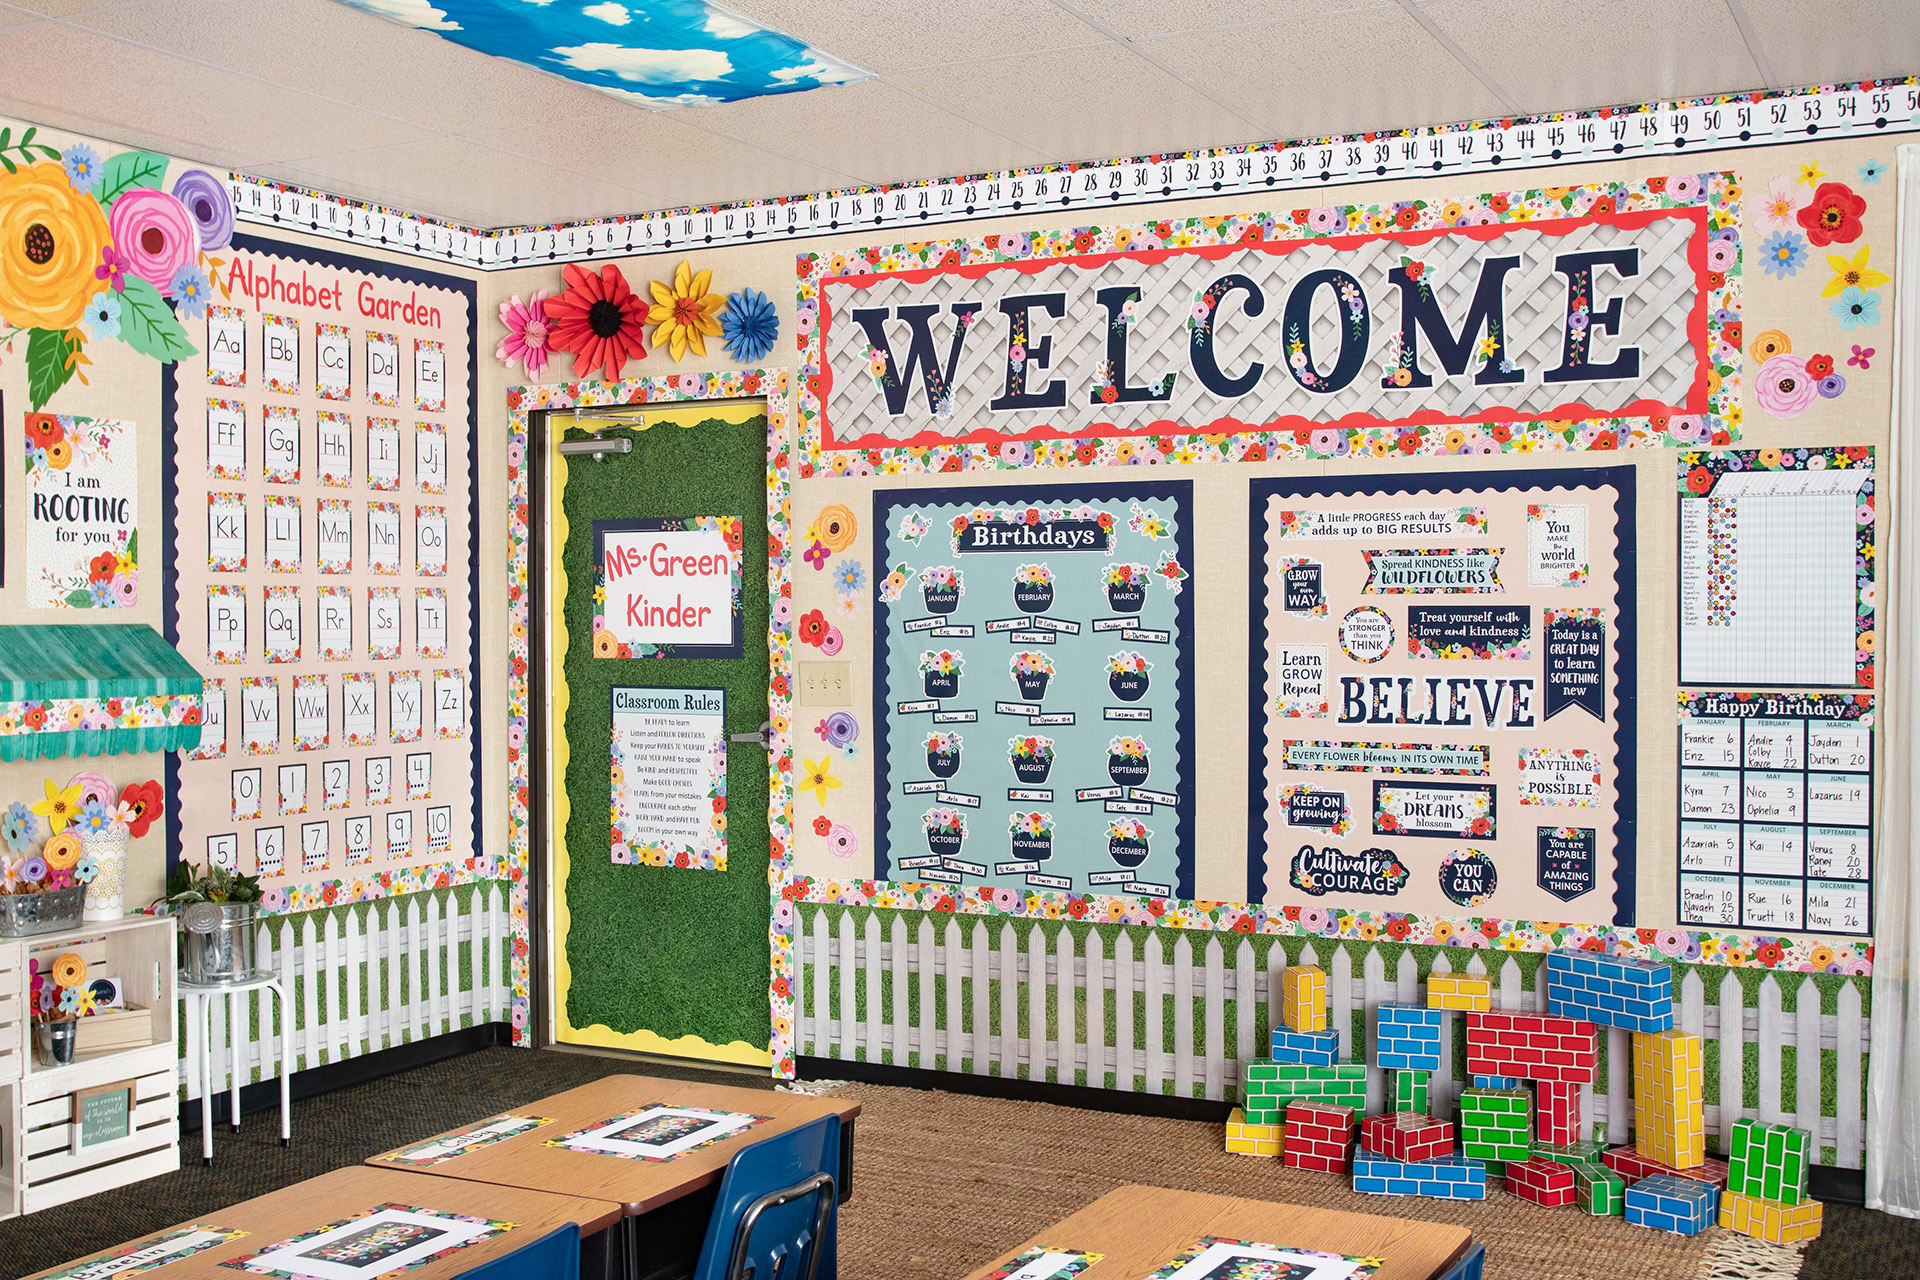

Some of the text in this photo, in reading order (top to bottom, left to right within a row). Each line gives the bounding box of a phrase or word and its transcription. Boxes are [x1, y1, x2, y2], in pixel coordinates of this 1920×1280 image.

[1737, 94, 1890, 127] 51 52 53 54 55
[227, 257, 441, 329] Alphabet Garden
[851, 247, 1639, 416] WELCOME
[213, 330, 438, 383] Aa Bb Cc Dd Ee
[65, 472, 101, 488] I am
[34, 493, 129, 524] ROOTING
[1317, 511, 1446, 522] A little PROGRESS each day
[1312, 523, 1452, 537] adds up to BIG RESULTS
[1546, 521, 1570, 533] You
[56, 527, 110, 545] for you
[971, 524, 1095, 548] Birthdays
[650, 543, 728, 577] Green
[1541, 548, 1575, 561] world
[1382, 558, 1485, 571] Spread KINDNESS like
[1287, 569, 1318, 582] GROW
[1381, 568, 1486, 584] WILDFLOWERS
[1292, 581, 1308, 590] your
[927, 594, 956, 602] JANUARY
[1017, 593, 1050, 601] FEBRUARY
[1113, 592, 1139, 600] MARCH
[1288, 594, 1318, 607] WAY
[627, 594, 711, 627] Kinder
[1419, 611, 1521, 625] Treat yourself with
[1348, 624, 1386, 632] STRONGER
[1419, 625, 1519, 636] love and kindness
[1369, 633, 1381, 641] you
[1552, 629, 1577, 642] Today
[1580, 631, 1588, 640] is
[1351, 639, 1383, 650] THINK
[1550, 643, 1599, 655] GREAT DAY
[1282, 651, 1322, 666] Learn
[1554, 658, 1595, 670] to learn
[1282, 668, 1322, 680] GROW
[1550, 672, 1599, 684] SOMETHING
[1025, 680, 1040, 688] MAY
[1121, 681, 1138, 689] JUNE
[1283, 681, 1322, 697] Repeat
[1563, 686, 1587, 695] new
[616, 692, 720, 711] Classroom Rules
[1338, 677, 1534, 727] BELIEVE
[1705, 699, 1845, 719] Happy Birthday
[1684, 733, 1734, 744] Frankie 6
[1749, 734, 1773, 745] Andie
[1292, 751, 1479, 764] EVERY FLOWER blooms IN ITS OWN TIME
[1748, 747, 1771, 758] Colby
[937, 759, 951, 767] JULY
[1809, 754, 1865, 765] Dutton 20
[1019, 763, 1045, 772] AUGUST
[1111, 766, 1147, 774] SEPTEMBER
[1529, 760, 1593, 772] ANYTHING
[1556, 772, 1565, 781] is
[1528, 783, 1592, 796] POSSIBLE
[1747, 786, 1766, 798] Nico
[1809, 788, 1842, 801] Lazarus
[679, 792, 702, 800] mistakes
[1293, 796, 1340, 807] KEEP ON
[1415, 792, 1454, 803] Let your
[1292, 807, 1343, 821] growing
[1404, 802, 1464, 819] DREAMS
[1747, 804, 1779, 816] Ophelia
[1416, 818, 1452, 829] blossom
[930, 836, 960, 844] OCTOBER
[1014, 841, 1050, 849] NOVEMBER
[1550, 840, 1566, 848] You
[1111, 847, 1146, 856] DECEMBER
[1546, 850, 1587, 859] CAPABLE
[1300, 849, 1384, 874] Cultivate
[1561, 861, 1572, 870] of
[1454, 865, 1482, 878] YOU
[1543, 872, 1589, 881] AMAZING
[1809, 868, 1826, 877] Tate
[1312, 873, 1396, 891] COURAGE
[1453, 879, 1483, 892] CAN
[1550, 882, 1584, 891] THINGS
[1809, 914, 1831, 926] Navy
[440, 1128, 500, 1150] Colby
